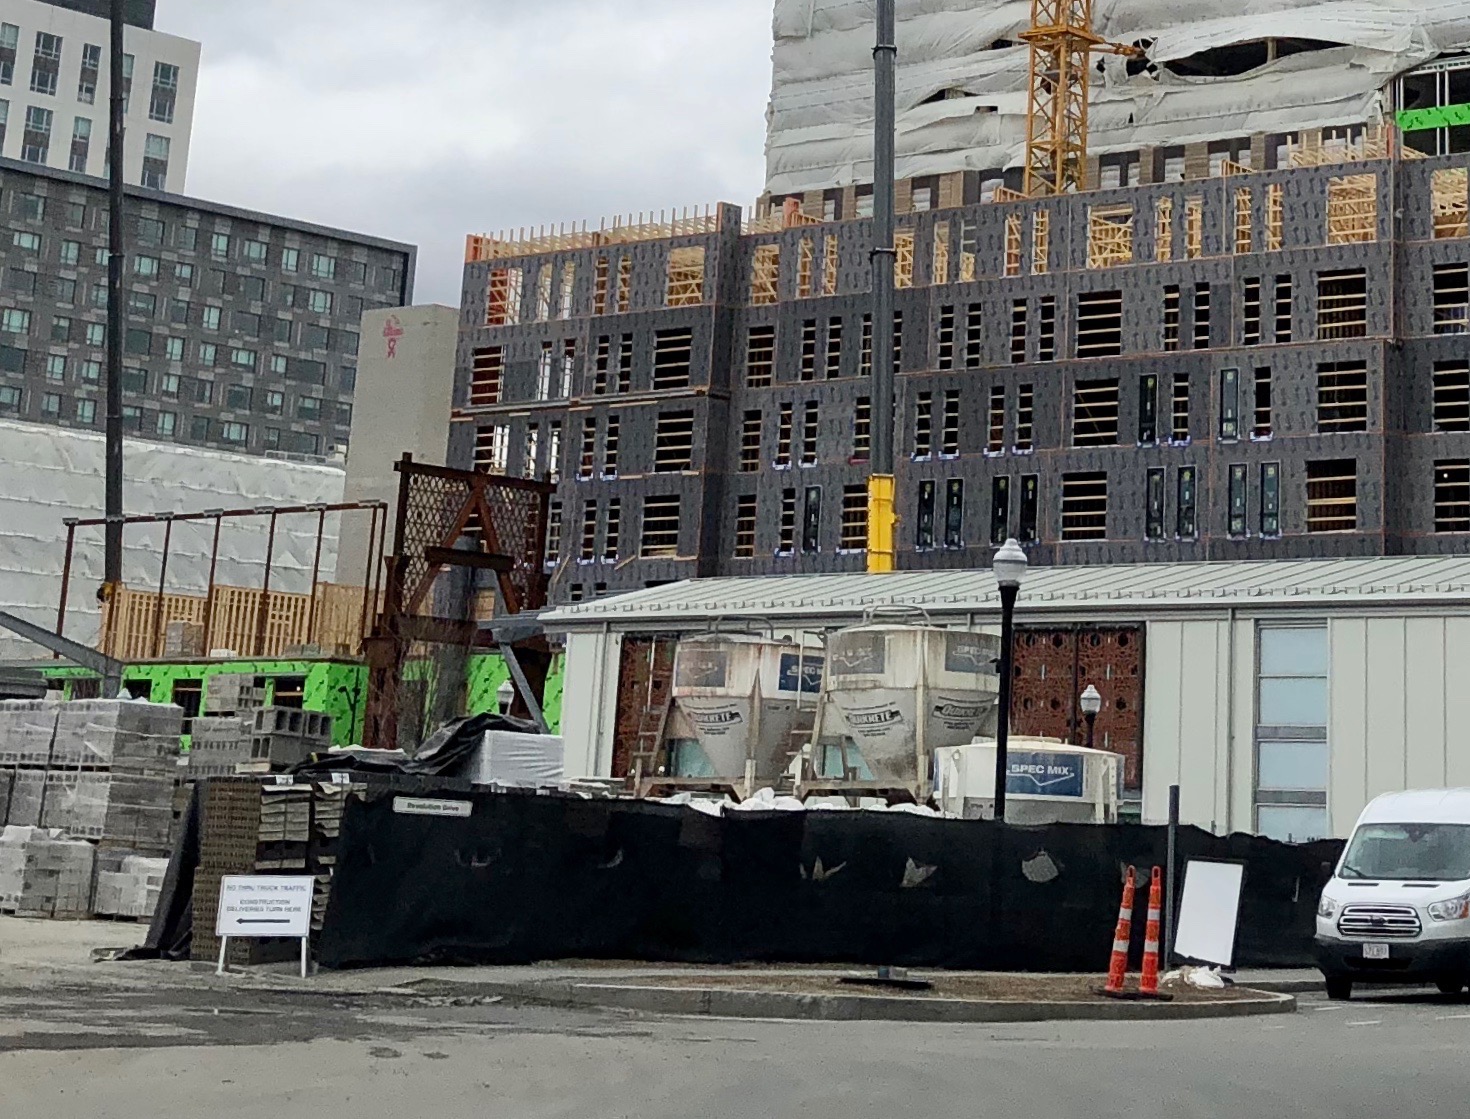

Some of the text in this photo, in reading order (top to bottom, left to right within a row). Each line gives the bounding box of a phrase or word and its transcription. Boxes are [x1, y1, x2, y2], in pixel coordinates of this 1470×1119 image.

[791, 665, 815, 674] SEC
[1012, 764, 1069, 775] SPEC MIX
